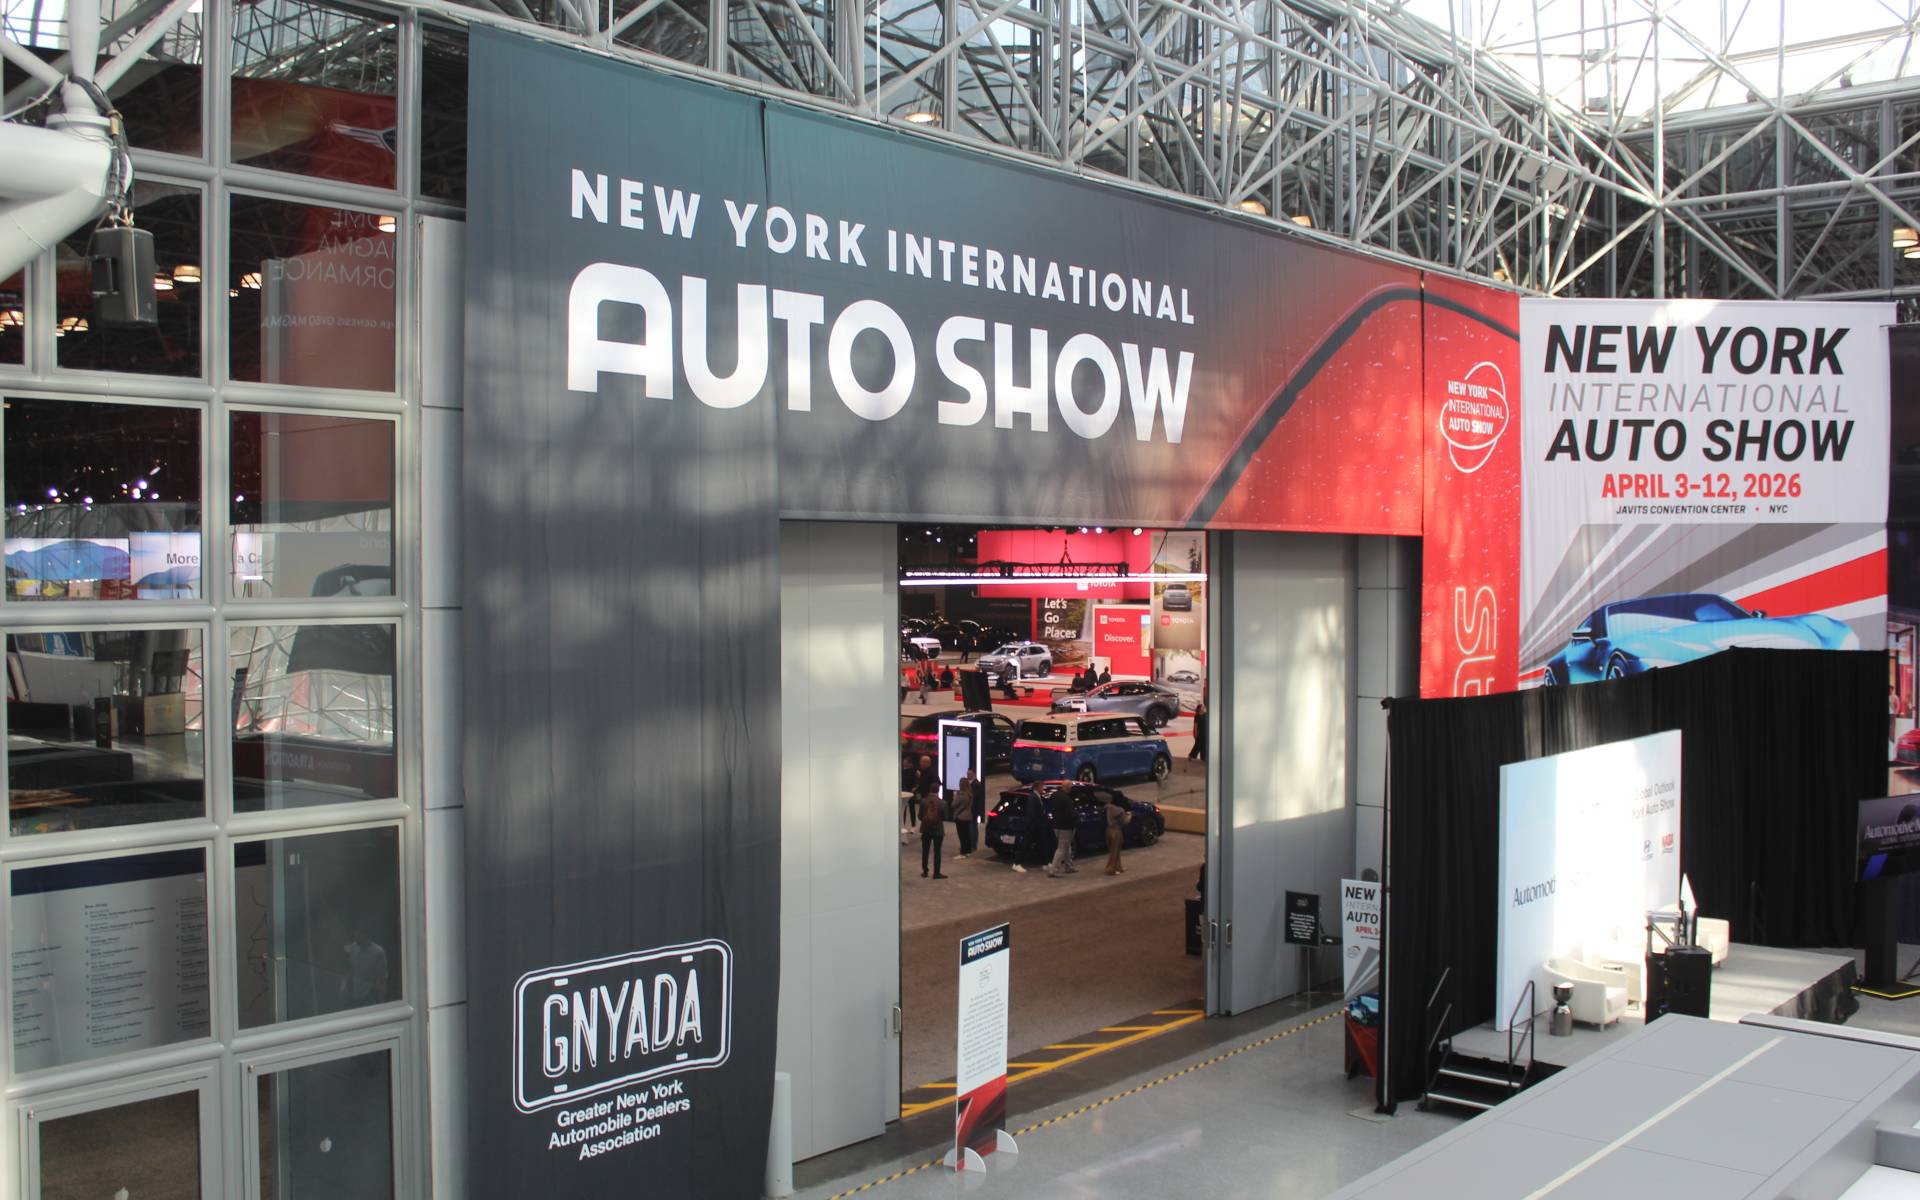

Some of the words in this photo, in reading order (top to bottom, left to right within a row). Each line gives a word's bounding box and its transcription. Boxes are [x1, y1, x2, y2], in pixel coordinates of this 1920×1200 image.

[570, 168, 701, 240] NEW
[724, 199, 867, 267] YORK
[887, 230, 1195, 326] INTERNATIONAL
[567, 261, 917, 421] AUTO
[935, 315, 1195, 444] SHOW
[1544, 324, 1677, 375] NEW
[1695, 326, 1850, 376] YORK
[1448, 380, 1466, 396] NEW
[1467, 383, 1488, 399] YORK
[1549, 382, 1850, 414] INTERNATIONAL
[1448, 398, 1504, 420] INTERNATIONAL
[1448, 417, 1470, 432] AUTO
[1471, 420, 1494, 435] SHOW
[1545, 419, 1687, 462] AUTO
[1702, 419, 1854, 463] SHOW
[1601, 473, 1669, 499] APRIL
[1675, 473, 1738, 502] 3-12,
[1743, 473, 1802, 499] 2026
[1616, 504, 1647, 515] JAVITS
[1649, 504, 1708, 515] CONVENTION
[1710, 504, 1746, 515] CENTER
[1768, 504, 1788, 515] NYC
[166, 552, 199, 565] More
[1044, 597, 1068, 609] Let's
[1044, 612, 1060, 624] Go
[1044, 626, 1077, 640] Places
[1345, 885, 1376, 901] NEW
[1346, 911, 1379, 925] AUTO
[968, 943, 985, 958] AUTO
[985, 935, 1004, 951] SHOW
[543, 968, 702, 1078] GNYADA
[556, 1099, 614, 1128] Greater
[616, 1089, 649, 1111] New
[651, 1079, 684, 1100] York
[548, 1112, 632, 1150] Automobile
[635, 1097, 691, 1124] Dealers
[579, 1123, 661, 1161] Association
